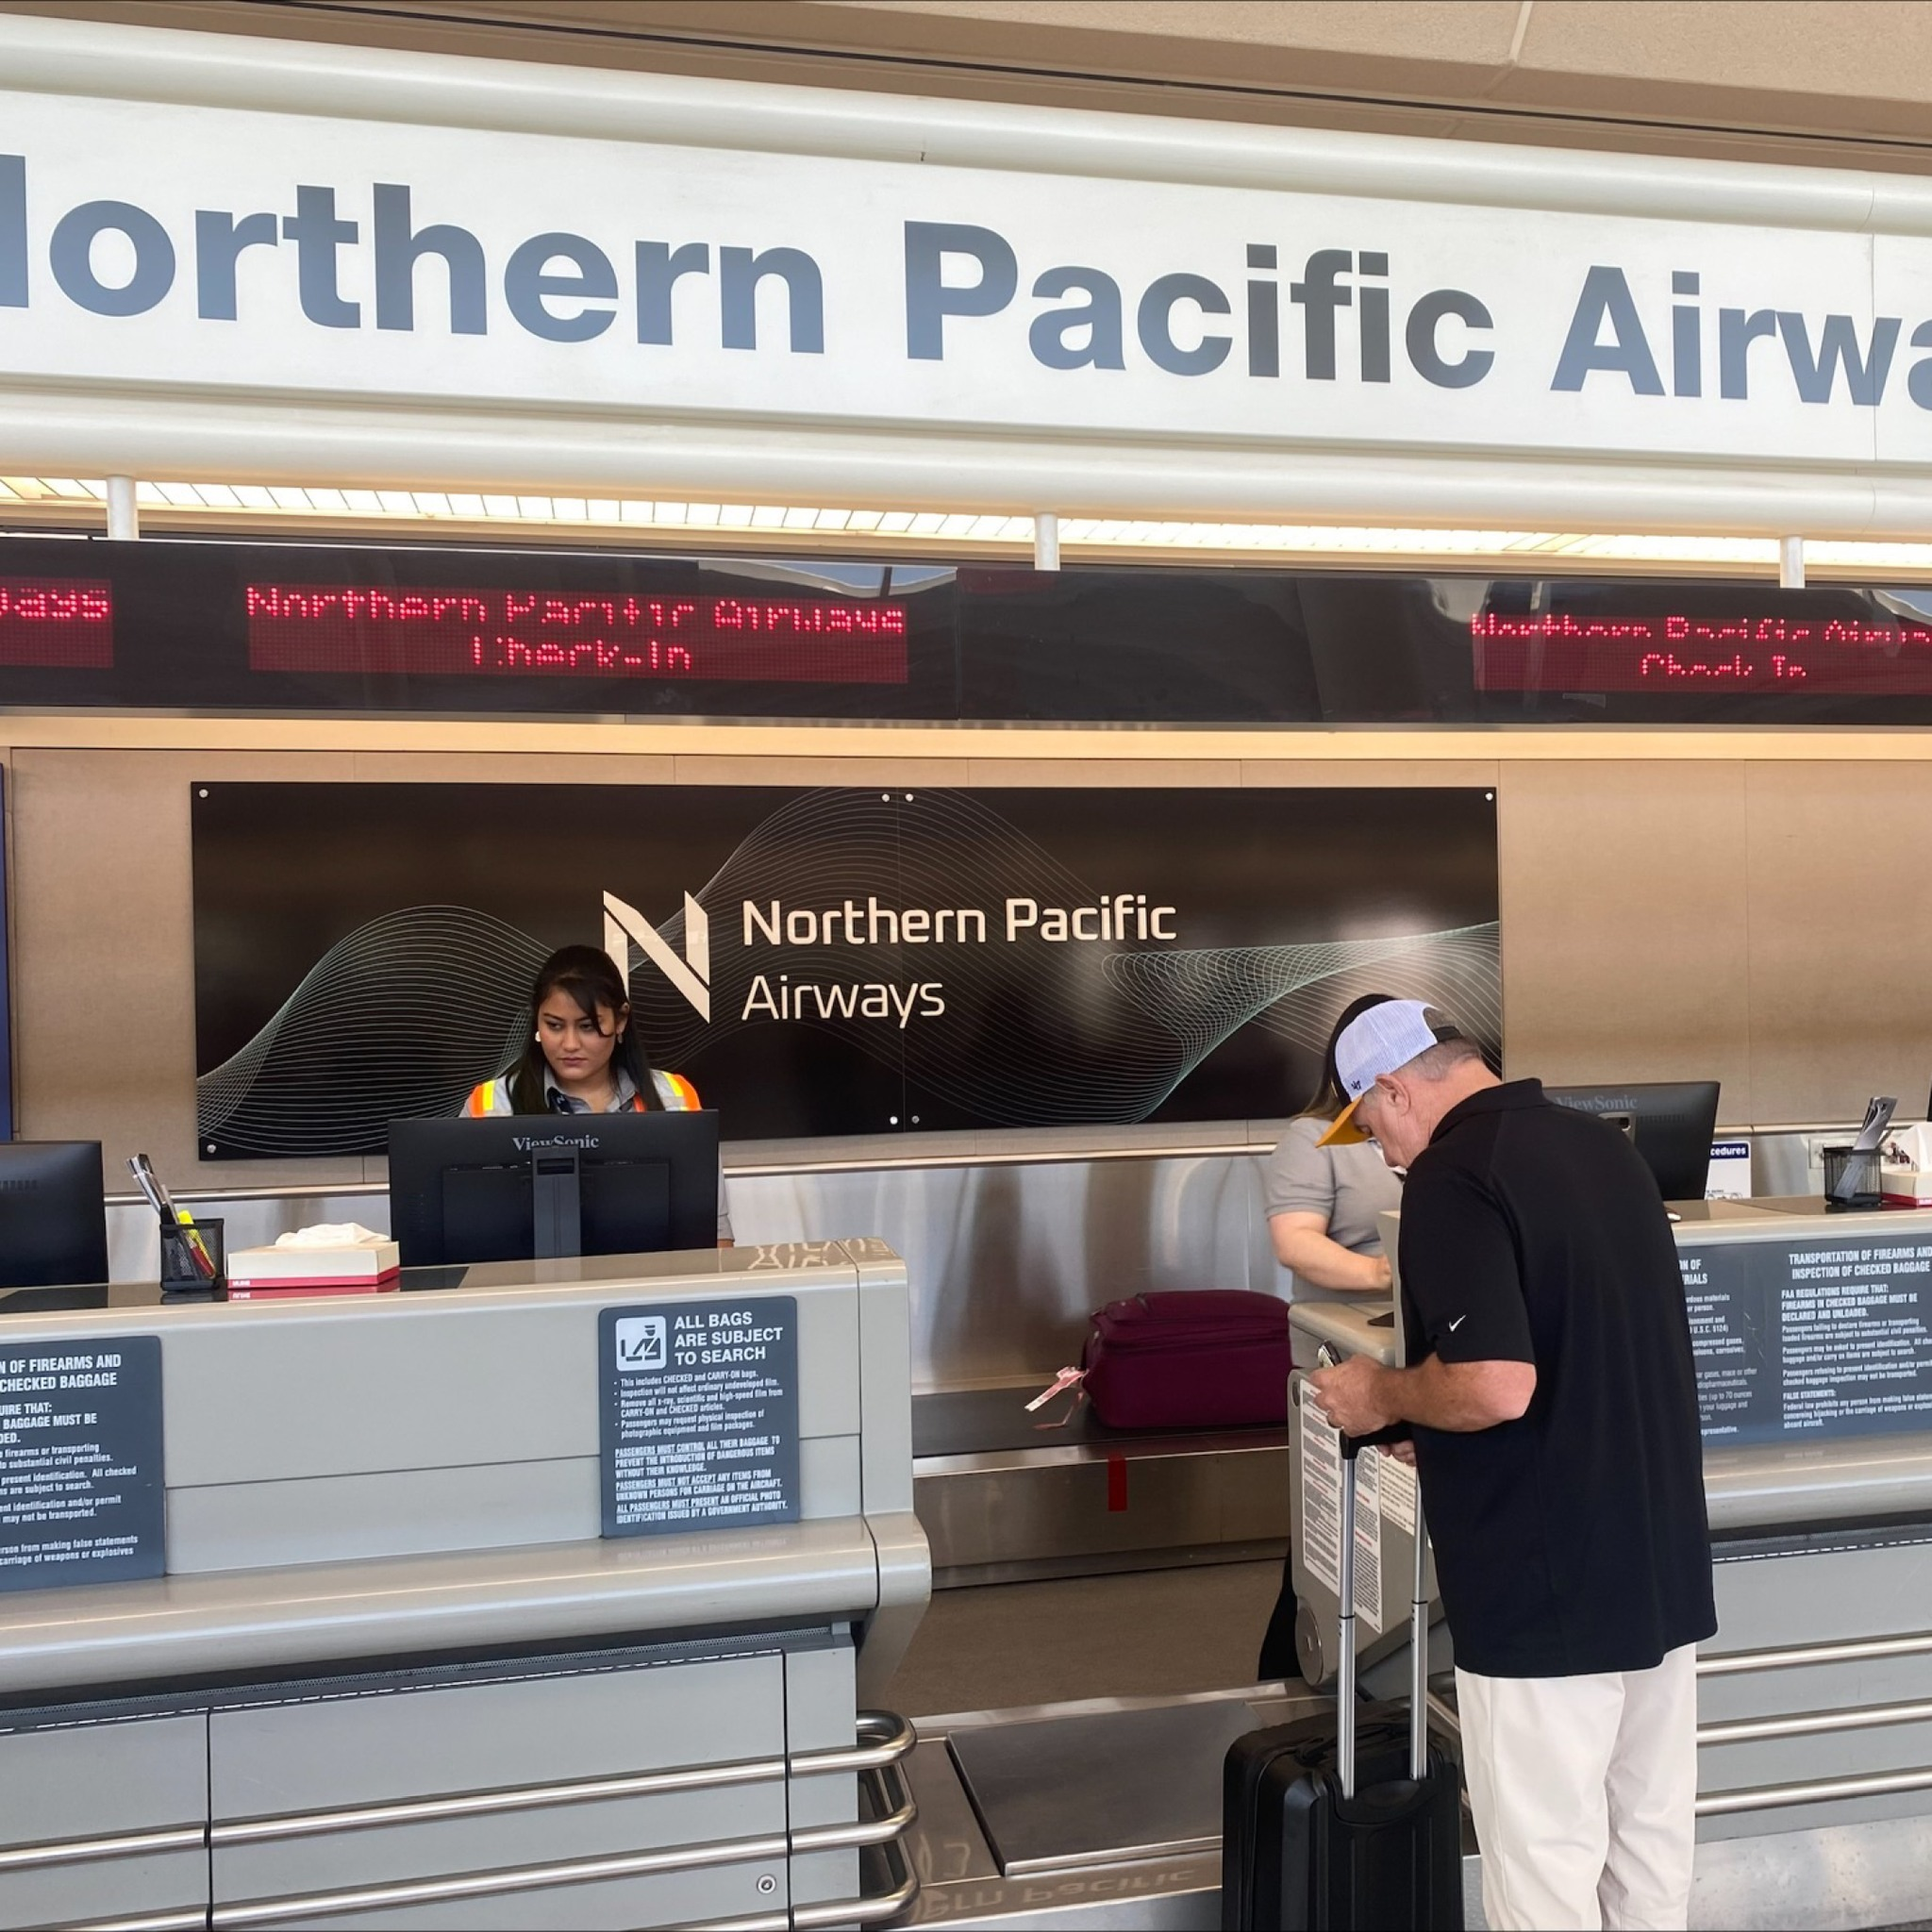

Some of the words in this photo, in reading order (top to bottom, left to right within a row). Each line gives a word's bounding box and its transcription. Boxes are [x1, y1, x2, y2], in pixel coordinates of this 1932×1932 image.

[0, 155, 824, 354] orthern
[904, 220, 1494, 389] Pacific
[1550, 265, 1932, 411] Airw
[742, 896, 986, 946] Northern
[1006, 893, 1178, 941] Pacific
[741, 974, 945, 1028] Airways
[1789, 1250, 1859, 1265] TRANSPORTATION
[1861, 1249, 1871, 1260] OF
[1874, 1247, 1914, 1260] FIREARMS
[1917, 1246, 1932, 1257] AND
[1792, 1266, 1840, 1279] INSPECTION
[1841, 1265, 1852, 1276] OF
[1855, 1263, 1890, 1275] CHECKED
[1893, 1261, 1930, 1274] BAGGAGE
[675, 1315, 704, 1329] ALL
[709, 1311, 752, 1327] BAGS
[675, 1332, 708, 1347] ARE
[711, 1327, 783, 1344] SUBJECT
[10, 1359, 25, 1374] OF
[29, 1356, 92, 1373] FIREARMS
[96, 1354, 121, 1369] AND
[675, 1352, 697, 1366] TO
[702, 1346, 766, 1364] SEARCH
[60, 1373, 117, 1389] BAGGAGE
[25, 1402, 52, 1414] THAT:
[4, 1416, 50, 1429] BAGGAGE
[53, 1414, 81, 1426] MUST
[85, 1413, 97, 1424] BE
